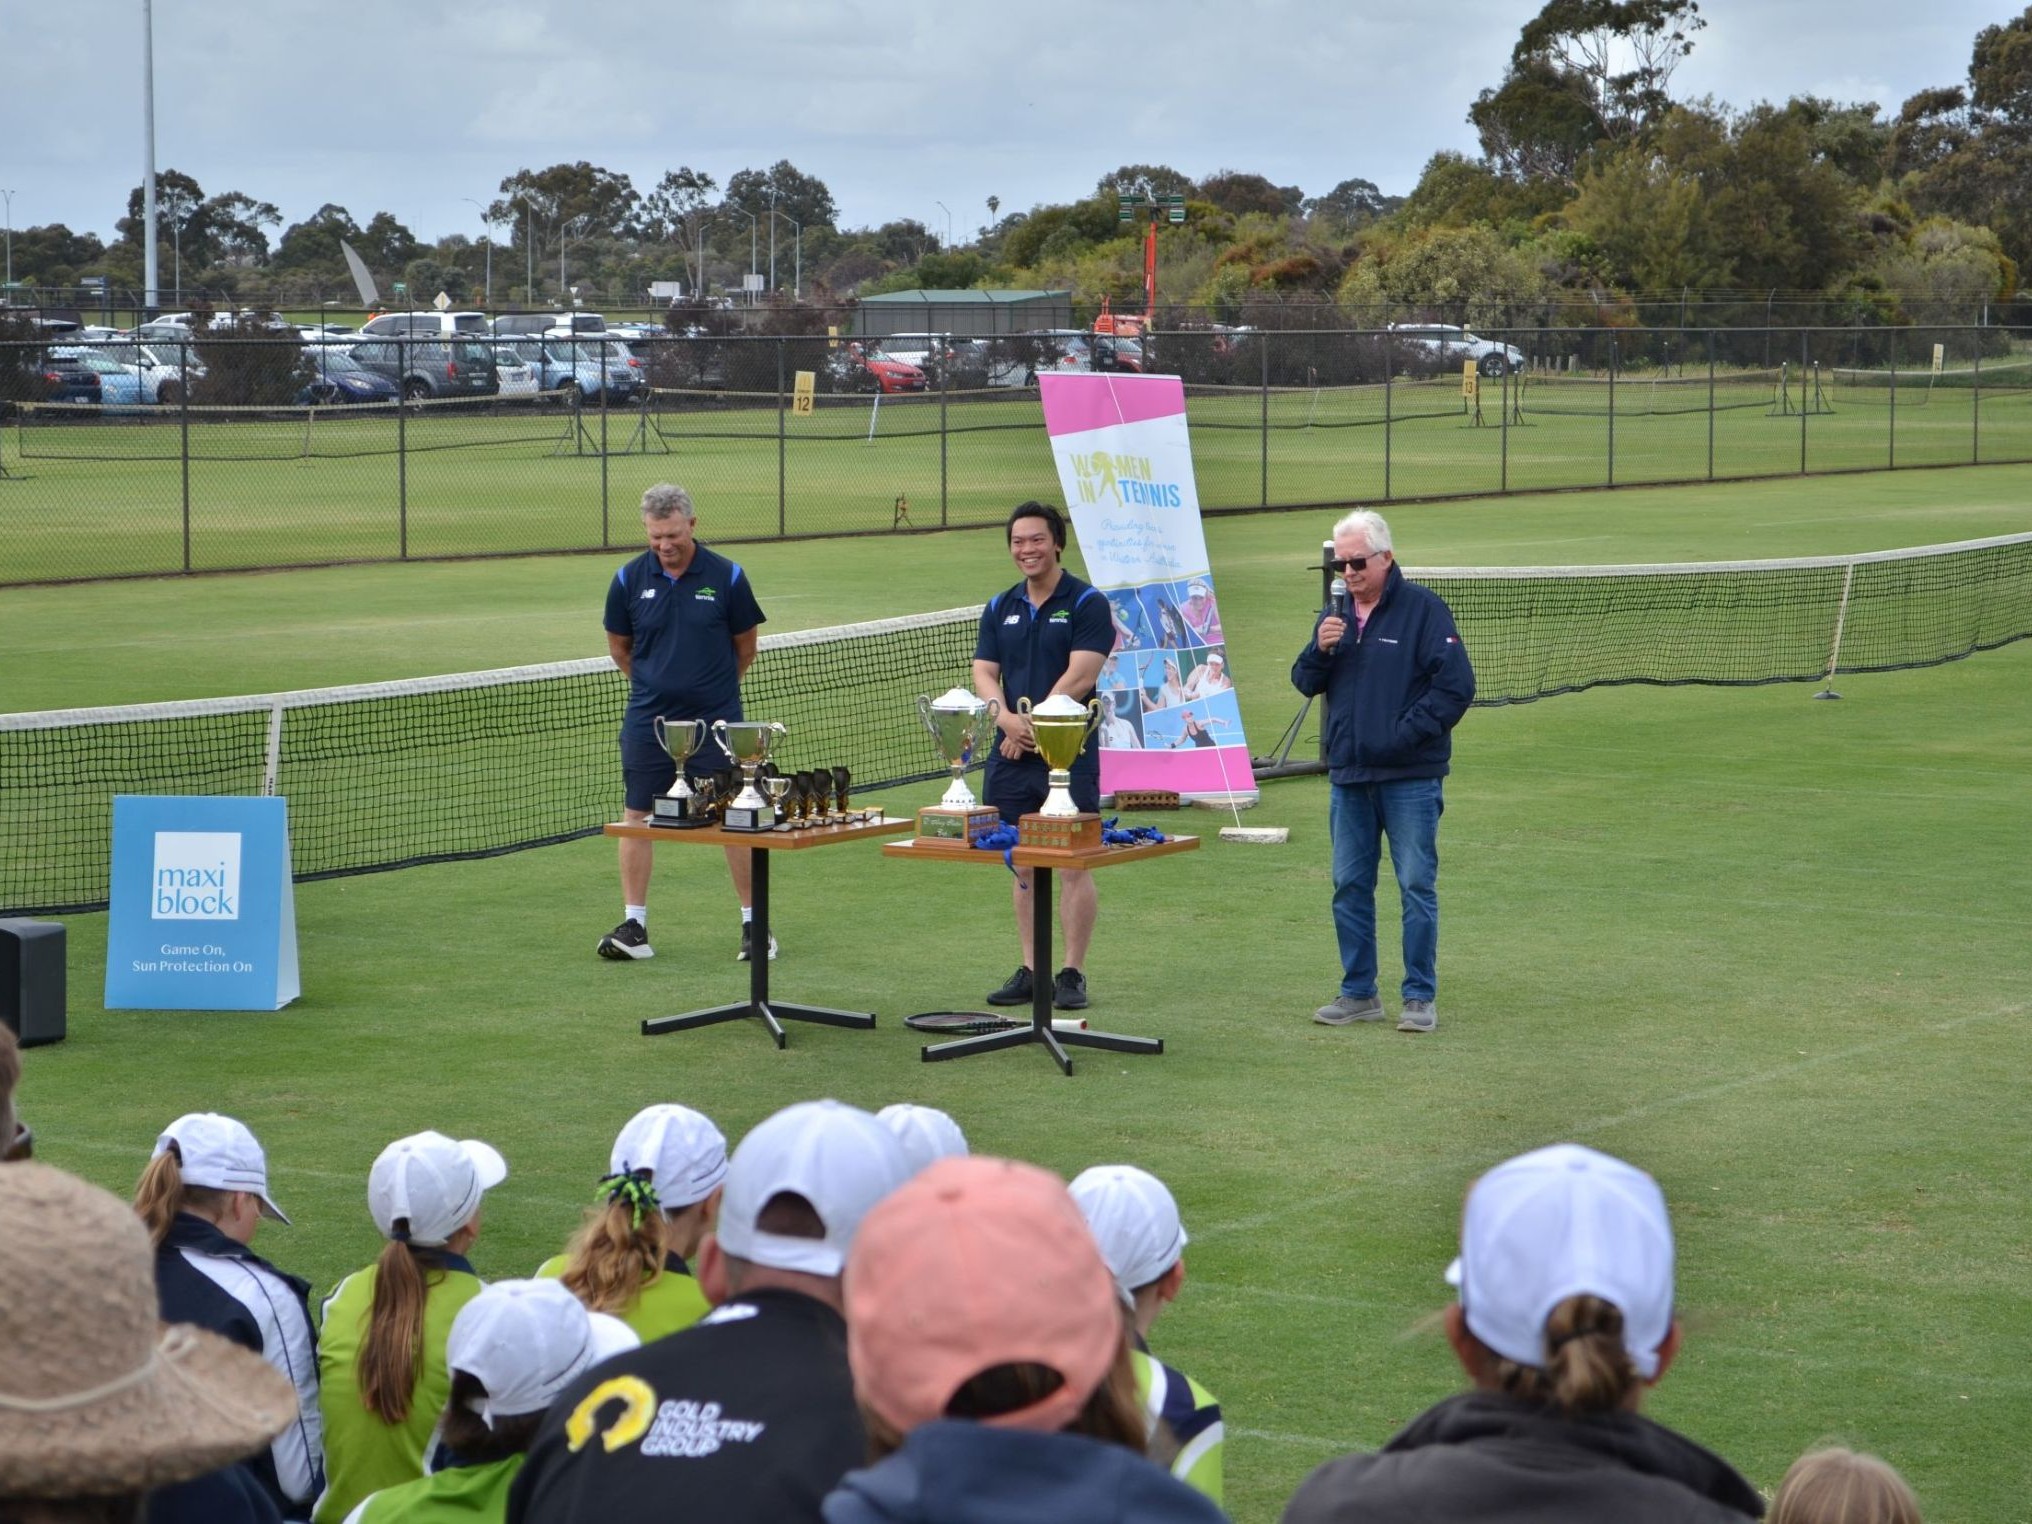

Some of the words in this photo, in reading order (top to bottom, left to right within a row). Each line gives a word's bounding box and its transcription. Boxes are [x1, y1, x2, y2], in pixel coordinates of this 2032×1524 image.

[797, 396, 810, 411] 12
[1077, 480, 1097, 504] IN
[1118, 480, 1181, 508] TENNIS
[158, 861, 224, 888] maxi
[157, 888, 234, 914] block
[160, 943, 200, 955] Game
[202, 944, 226, 957] On,
[132, 960, 156, 972] Sun
[159, 960, 230, 973] Protection
[233, 961, 253, 973] On
[658, 1400, 722, 1420] GOLD
[649, 1419, 765, 1442] INDUSTRY
[640, 1436, 721, 1458] GROUP
